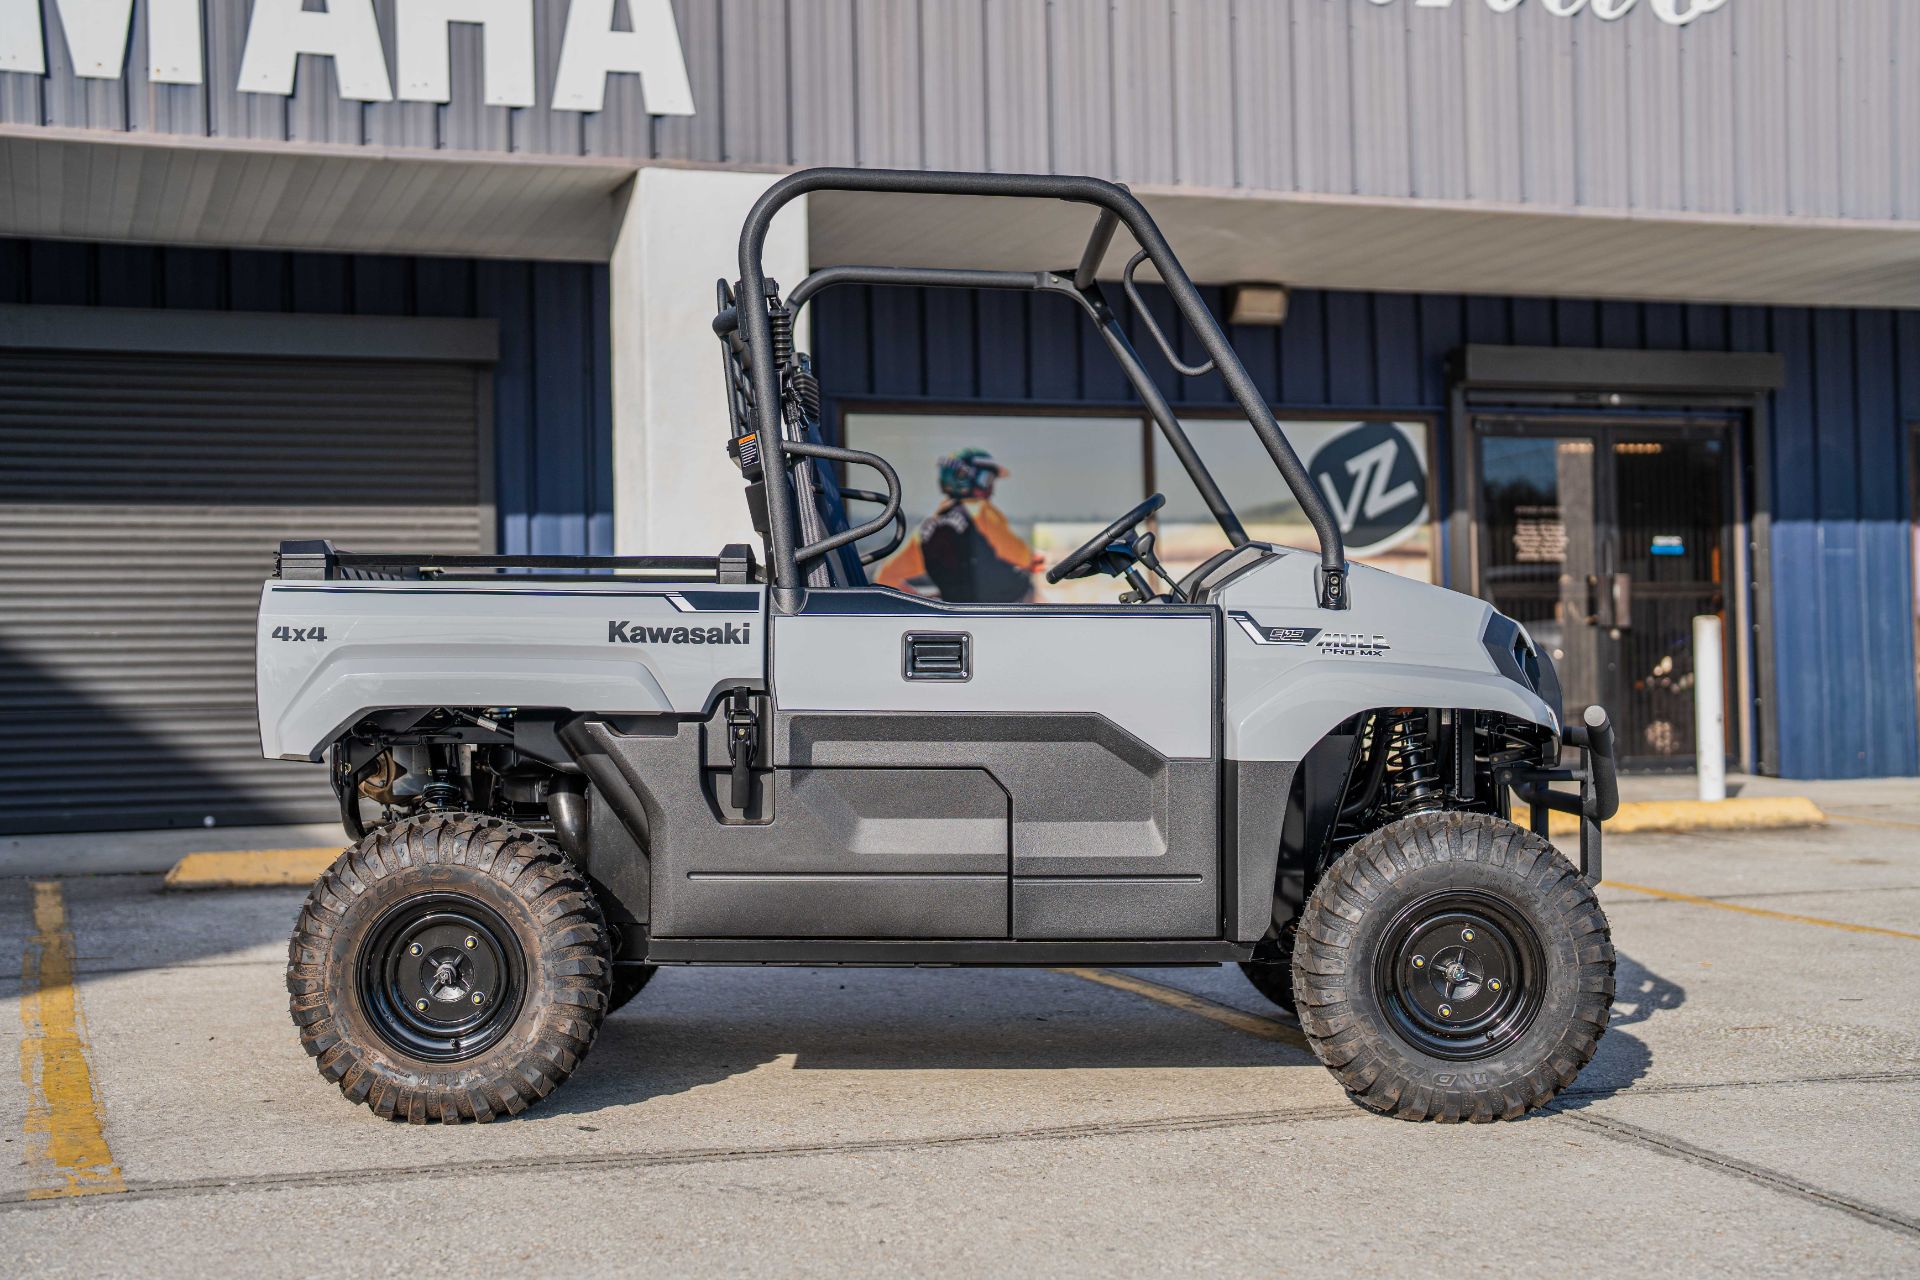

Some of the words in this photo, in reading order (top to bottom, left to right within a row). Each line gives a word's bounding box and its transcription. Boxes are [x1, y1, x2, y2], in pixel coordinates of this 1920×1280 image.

[1318, 438, 1419, 533] VZ
[271, 625, 328, 642] 4x4
[608, 620, 751, 645] Kawasaki
[1315, 633, 1391, 650] MULE
